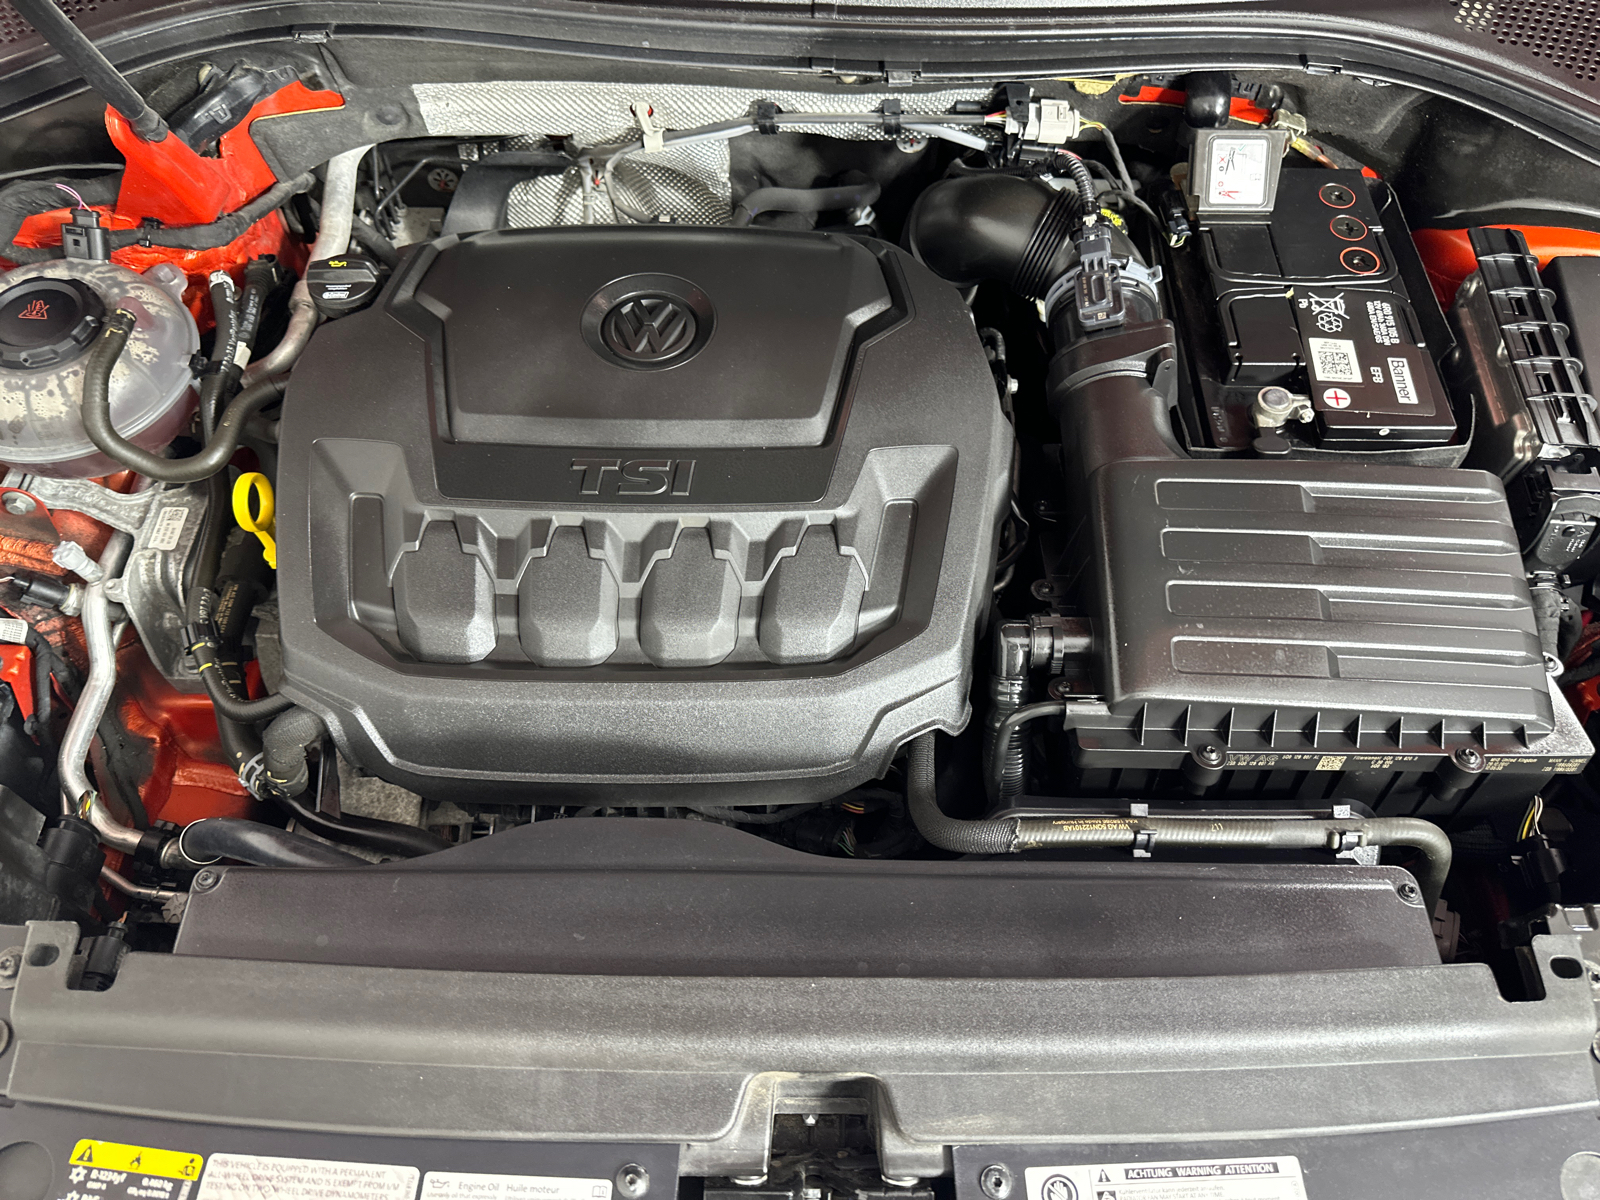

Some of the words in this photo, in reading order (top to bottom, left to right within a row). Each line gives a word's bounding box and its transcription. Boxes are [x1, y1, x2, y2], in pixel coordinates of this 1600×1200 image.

[1298, 298, 1309, 309] Pb
[1370, 366, 1384, 384] EFB
[1390, 359, 1412, 402] Banner
[570, 458, 697, 496] TSI
[271, 1163, 310, 1174] EQUIPPED
[310, 1167, 331, 1175] WITH
[340, 1168, 387, 1179] PERMANENT
[1127, 1168, 1173, 1179] ACHTUNG
[1175, 1165, 1222, 1177] WARNING
[1224, 1163, 1274, 1175] ATTENTION
[206, 1181, 237, 1191] TESTING
[301, 1188, 324, 1198] DRIVE
[325, 1189, 390, 1200] DYNAMOMETERS
[305, 1177, 323, 1186] AND
[333, 1178, 363, 1188] EXEMPT
[363, 1180, 386, 1190] FROM
[458, 1181, 486, 1193] Engine
[487, 1182, 500, 1191] Oil
[506, 1183, 528, 1192] Huile
[529, 1185, 560, 1194] moteur
